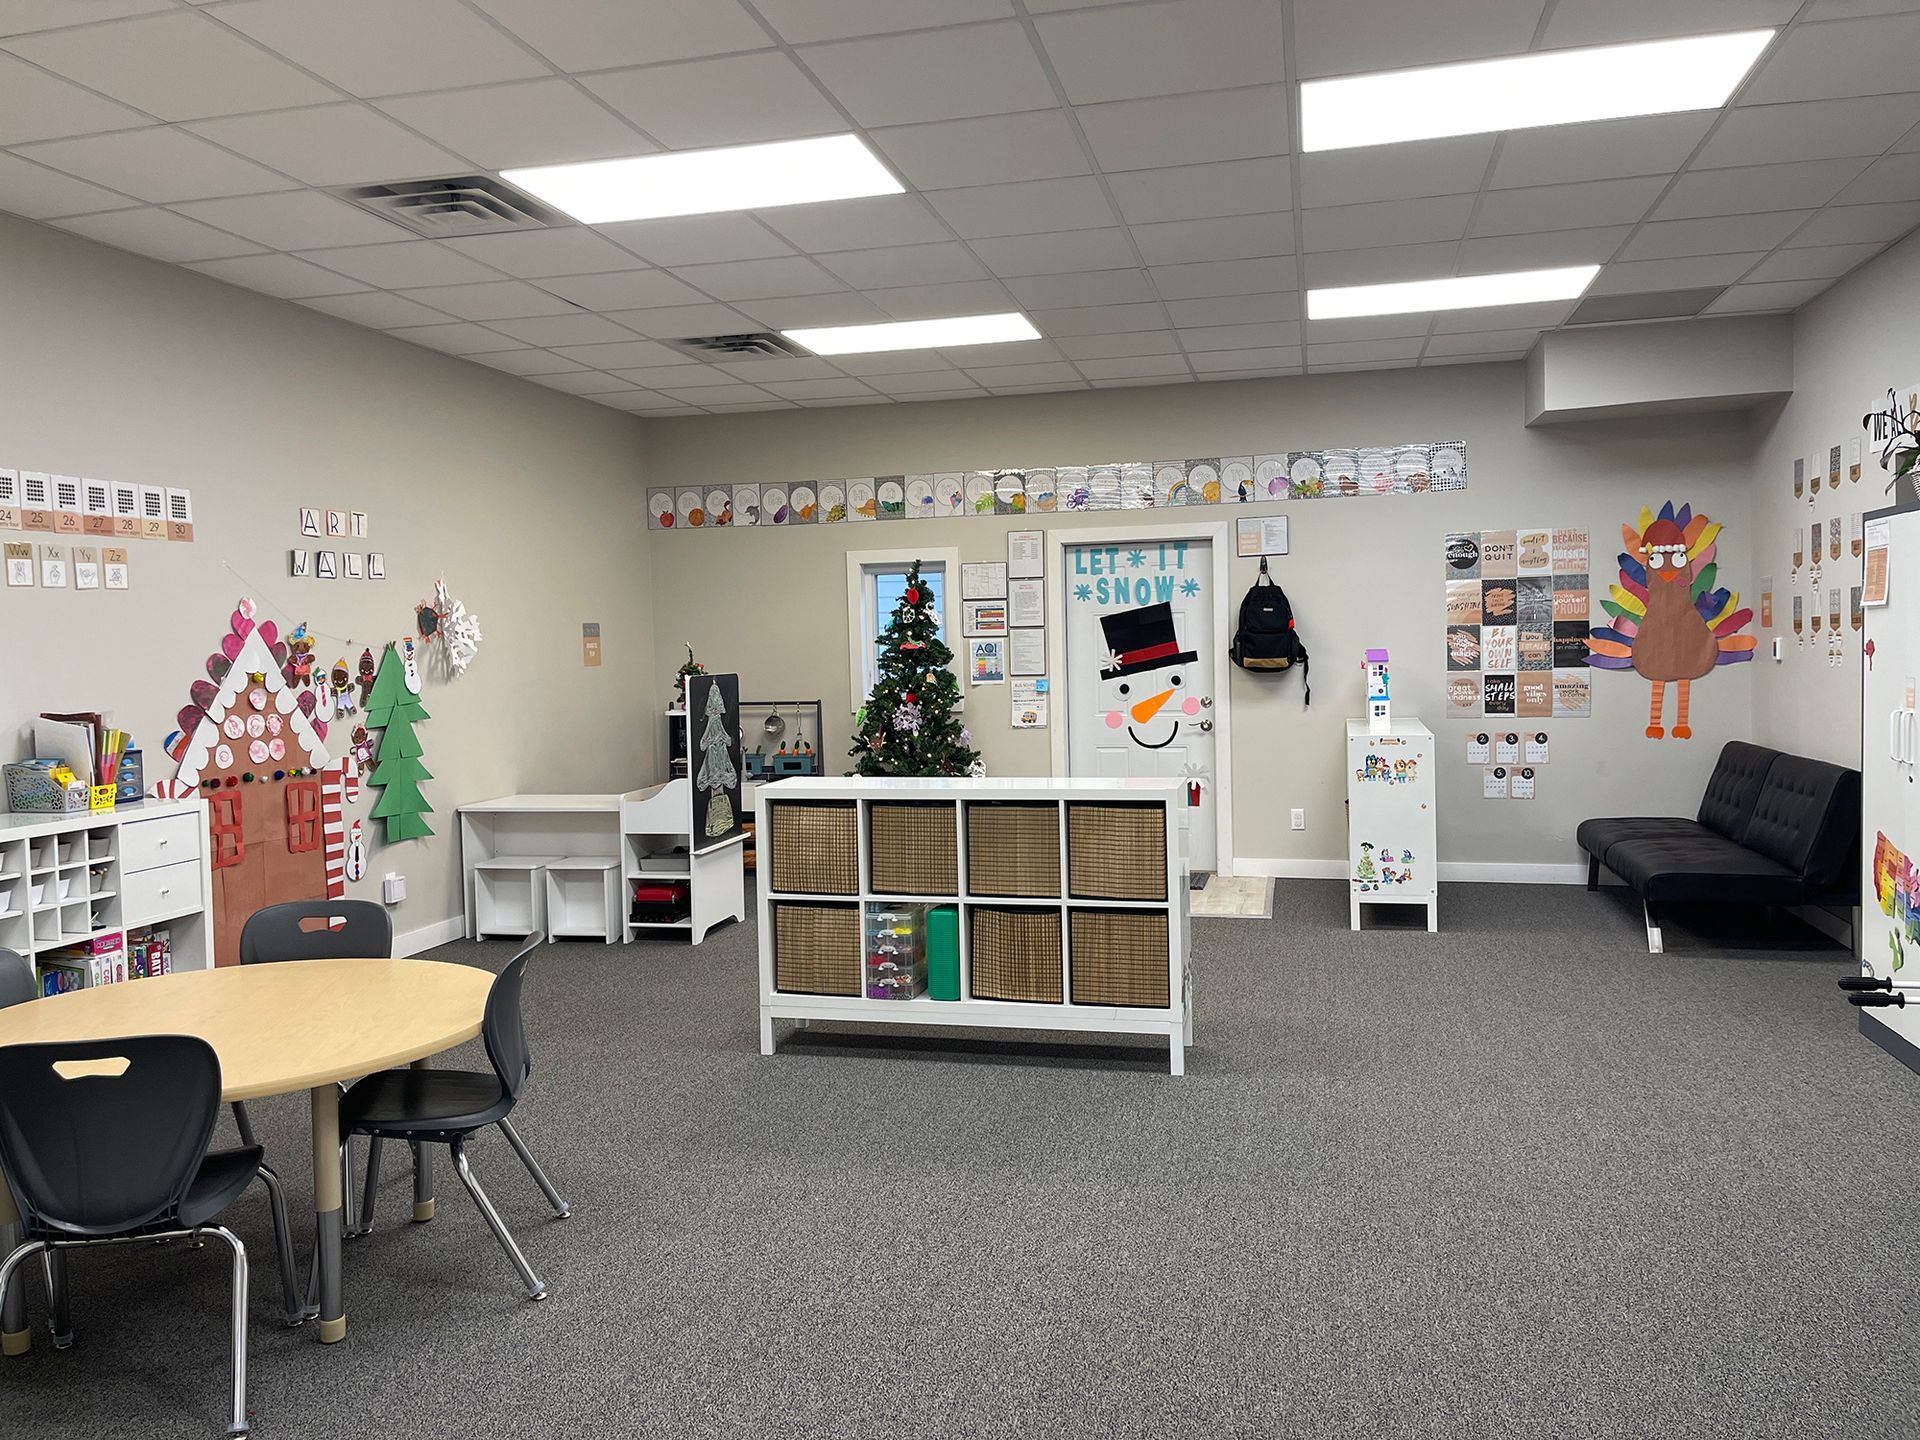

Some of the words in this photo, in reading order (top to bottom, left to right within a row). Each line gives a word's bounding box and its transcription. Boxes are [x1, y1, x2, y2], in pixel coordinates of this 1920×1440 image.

[0, 510, 12, 521] 24
[31, 511, 43, 523] 25
[63, 514, 75, 526] 26
[92, 517, 104, 528] 27
[121, 519, 133, 530] 28
[149, 521, 160, 532] 29
[304, 510, 364, 535] ART
[175, 524, 186, 534] 30
[1553, 533, 1587, 543] BECAUSE
[9, 544, 29, 557] Ww
[48, 546, 60, 558] Xx
[1484, 544, 1514, 552] DON'T
[80, 549, 91, 562] Yy
[109, 550, 121, 561] Zz
[1075, 547, 1120, 575] LET
[1159, 543, 1188, 571] IT
[1446, 551, 1478, 559] enough
[1096, 576, 1175, 606] SNOW
[1554, 603, 1587, 615] PROUD
[1491, 627, 1506, 638] BE
[976, 643, 997, 653] AQI
[1485, 637, 1514, 649] YOUR
[1488, 648, 1512, 658] OWN
[1488, 659, 1512, 669] SELF
[1485, 682, 1514, 692] SMALL
[1523, 684, 1543, 692] good
[1554, 682, 1589, 690] amazing
[1484, 692, 1515, 701] STEPS
[1526, 696, 1544, 705] only
